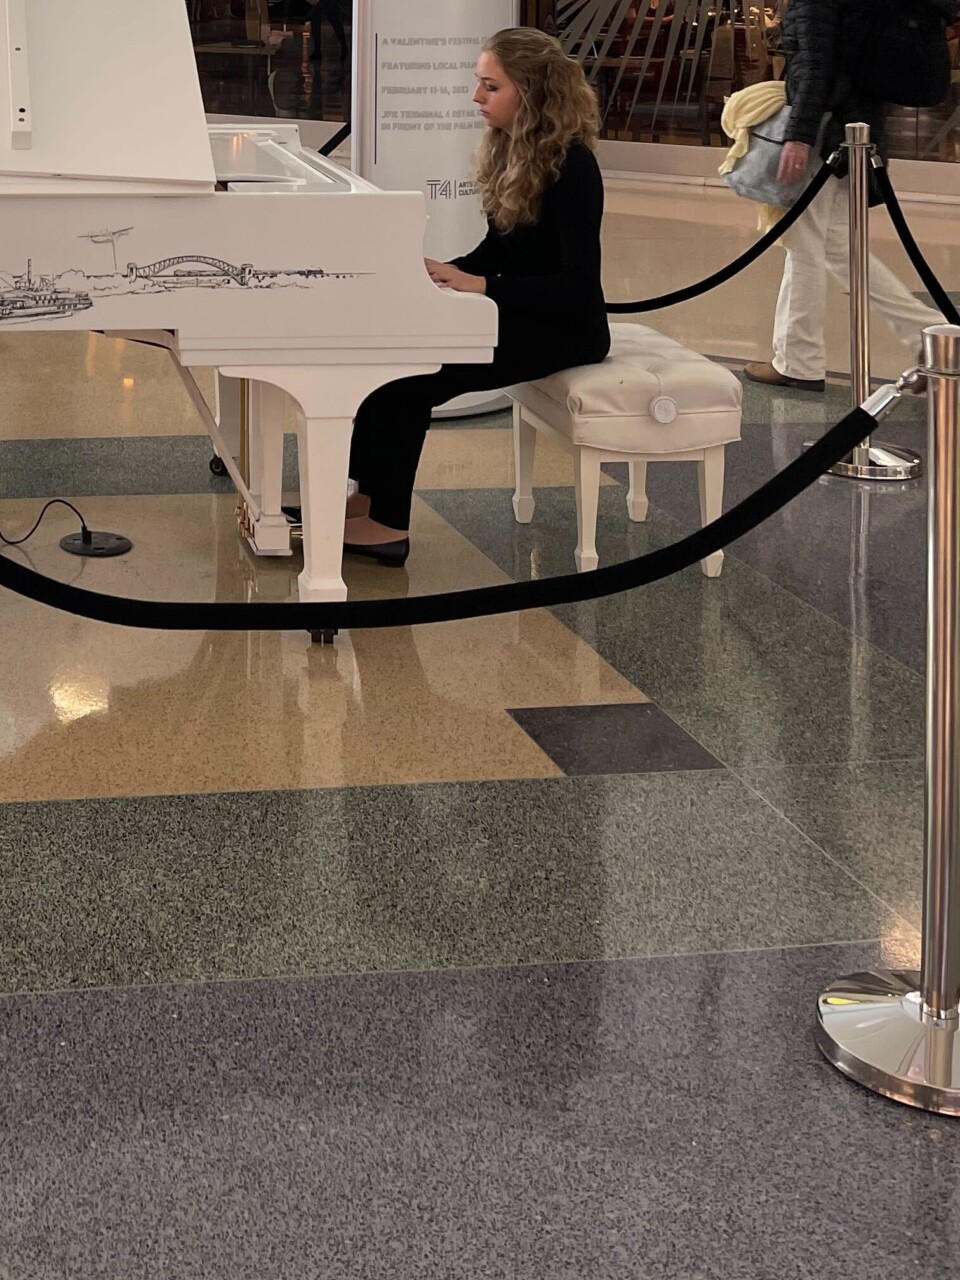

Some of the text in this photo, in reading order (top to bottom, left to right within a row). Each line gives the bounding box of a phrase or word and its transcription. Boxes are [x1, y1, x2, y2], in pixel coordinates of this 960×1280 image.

[390, 37, 446, 46] VALENTINE'S
[448, 37, 480, 46] FESTIVAL
[381, 62, 431, 70] FEATURING
[433, 61, 458, 69] LOCAL
[381, 86, 428, 94] FEBRUARY
[400, 110, 443, 118] TERMINAL
[426, 179, 452, 200] T4
